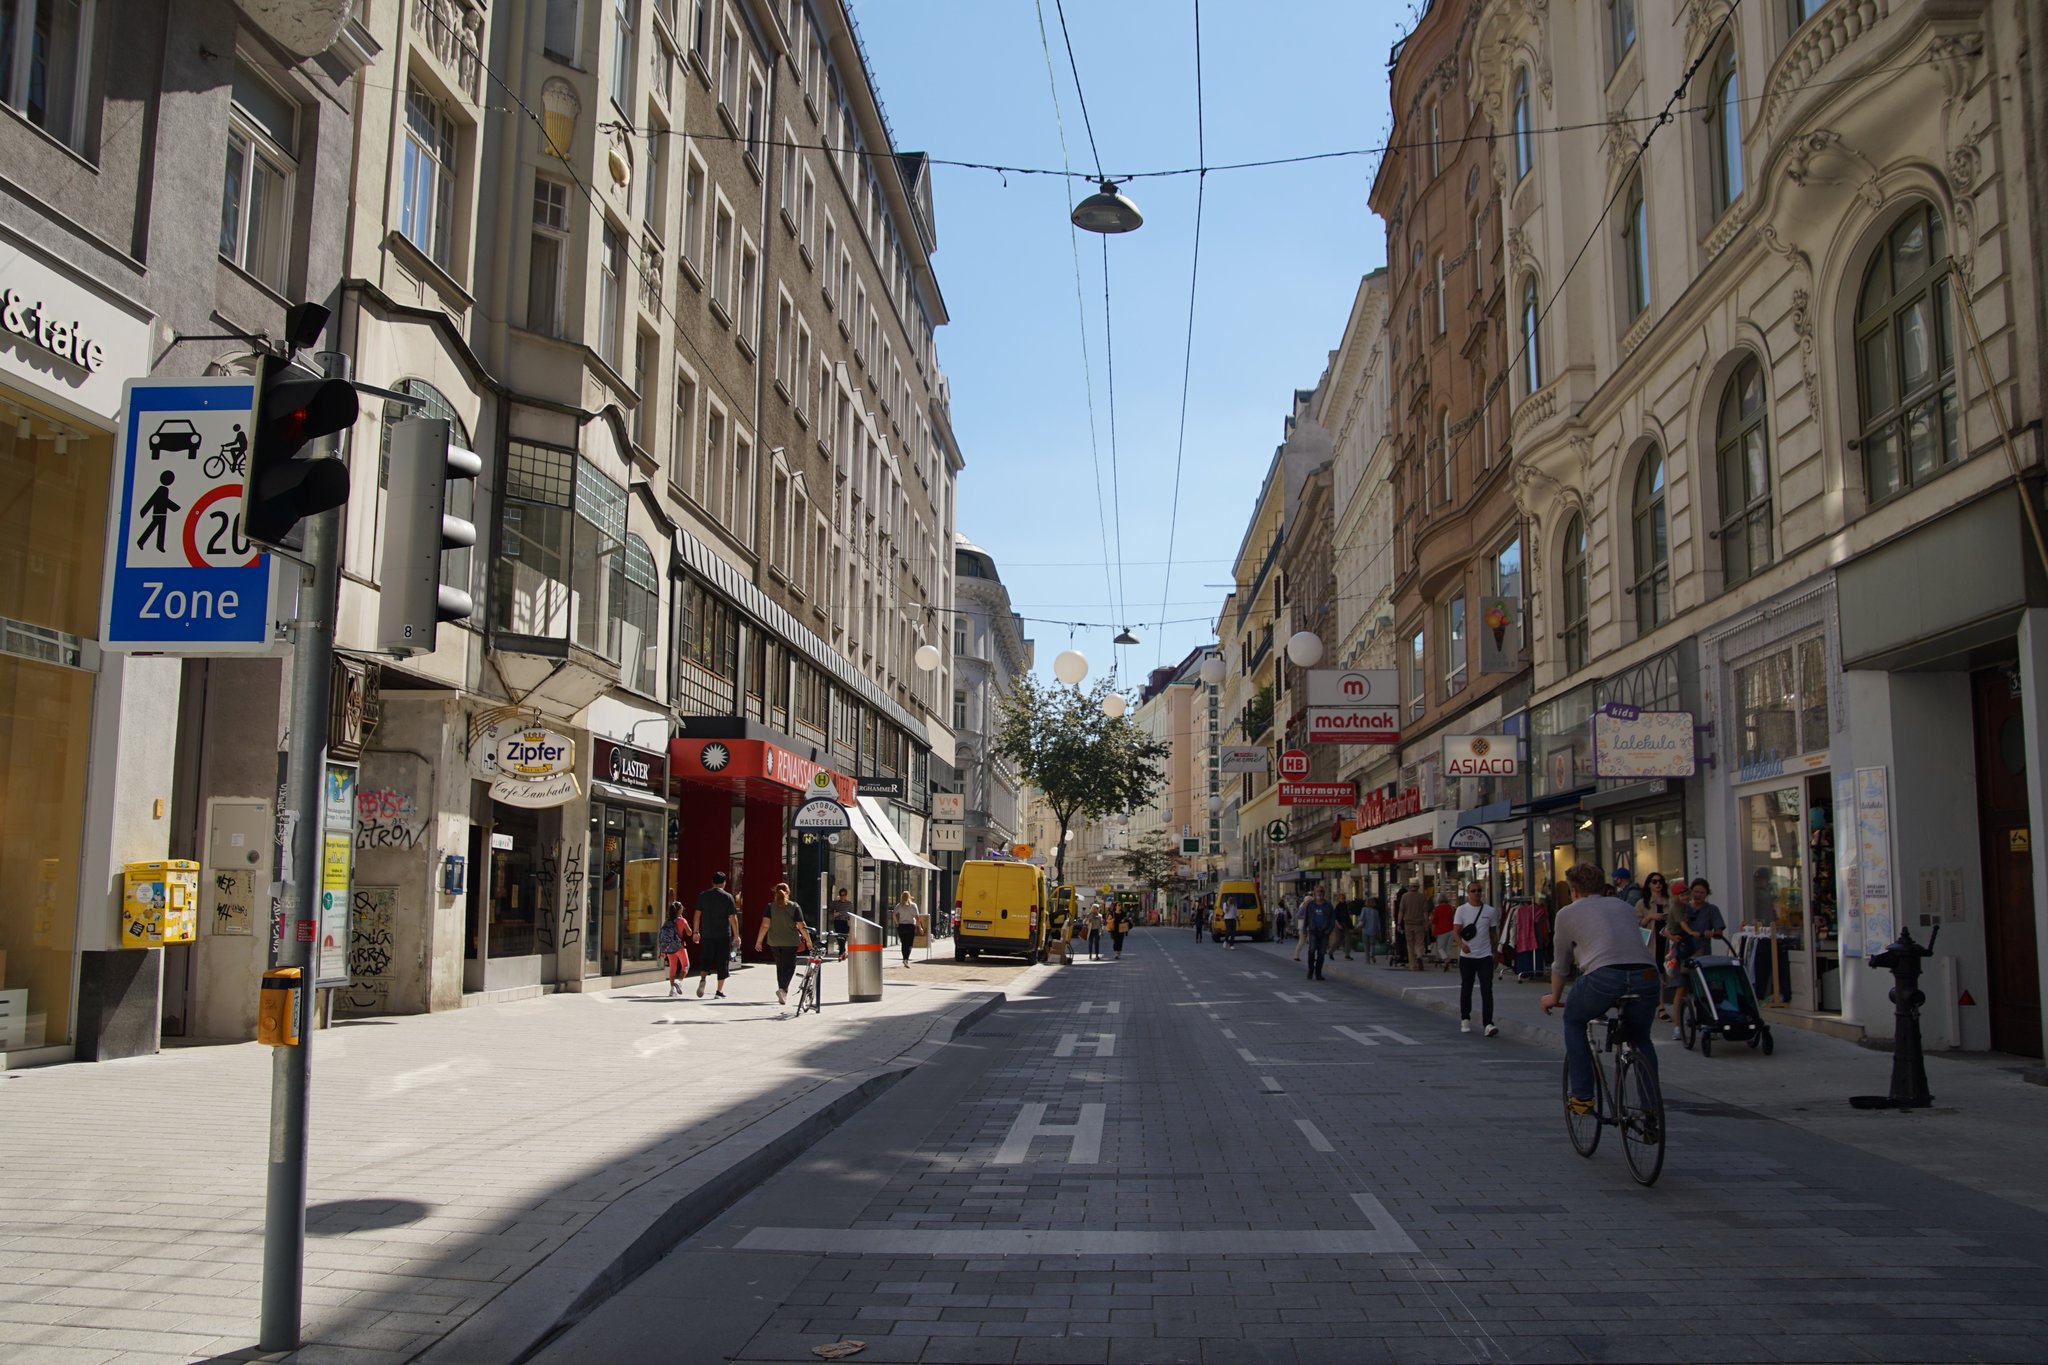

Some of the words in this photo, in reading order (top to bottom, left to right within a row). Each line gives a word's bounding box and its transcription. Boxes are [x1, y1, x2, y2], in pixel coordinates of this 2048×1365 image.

[139, 582, 239, 619] Zone
[404, 625, 413, 638] 8
[1344, 681, 1363, 695] m
[1315, 712, 1393, 728] mastnak
[1612, 707, 1634, 718] kids
[1613, 734, 1676, 750] lalekula
[507, 742, 565, 764] Zipfer
[1286, 759, 1304, 770] HB
[1449, 759, 1514, 774] ASIACO
[818, 775, 826, 784] H
[520, 782, 571, 799] Lambada
[1282, 785, 1352, 797] Hintermayer
[806, 801, 839, 814] AUTOBUS
[1053, 1033, 1116, 1057] H
[993, 1103, 1107, 1164] H
